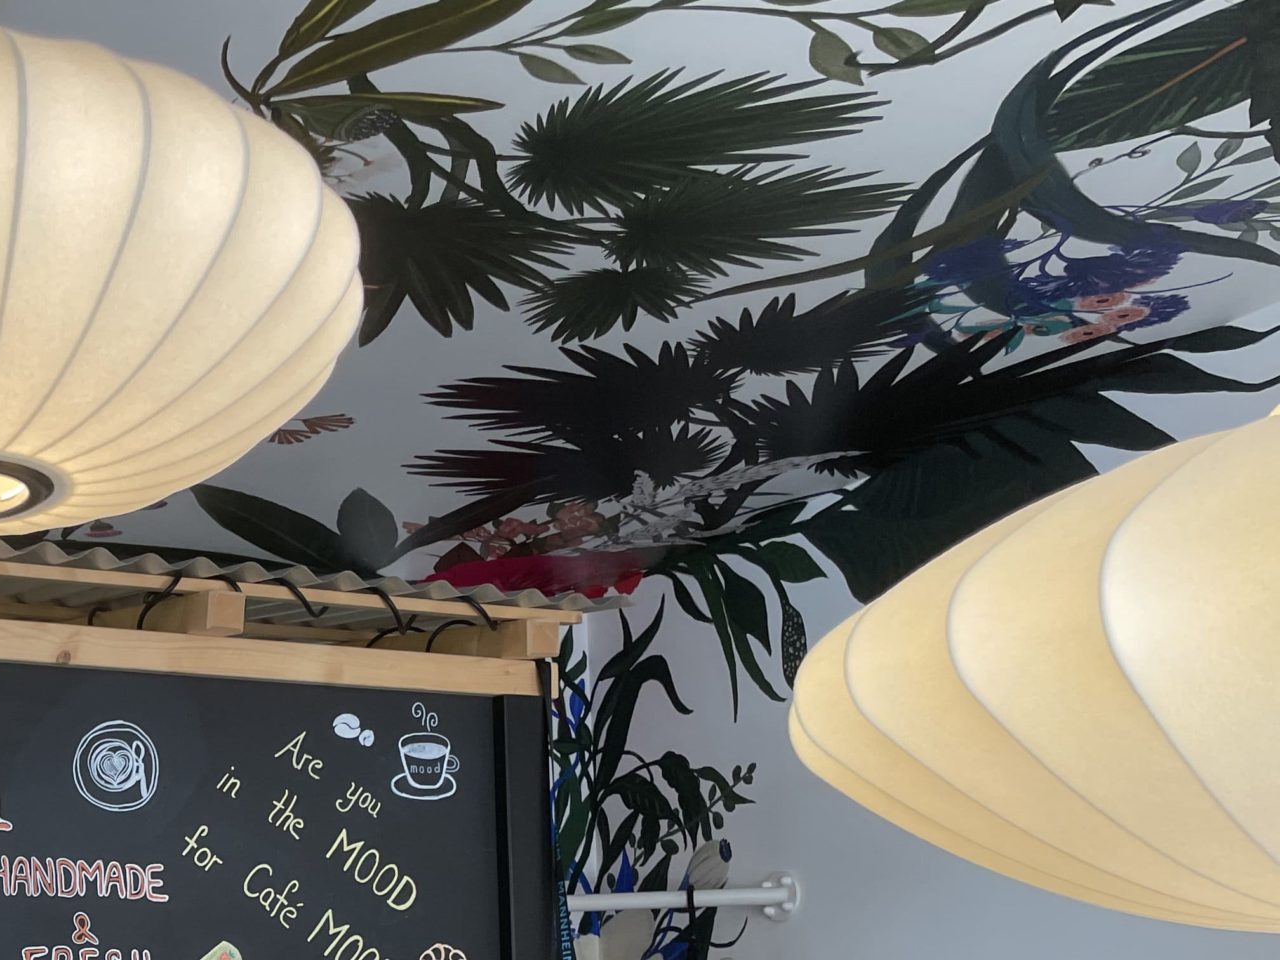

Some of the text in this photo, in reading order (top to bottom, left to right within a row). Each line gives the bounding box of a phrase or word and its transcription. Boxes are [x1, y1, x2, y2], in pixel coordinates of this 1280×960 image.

[274, 731, 381, 818] Are you
[410, 762, 441, 774] mood
[181, 825, 223, 871] for
[243, 863, 305, 929] Café
[216, 766, 417, 911] in the MOOD
[72, 911, 99, 945] &
